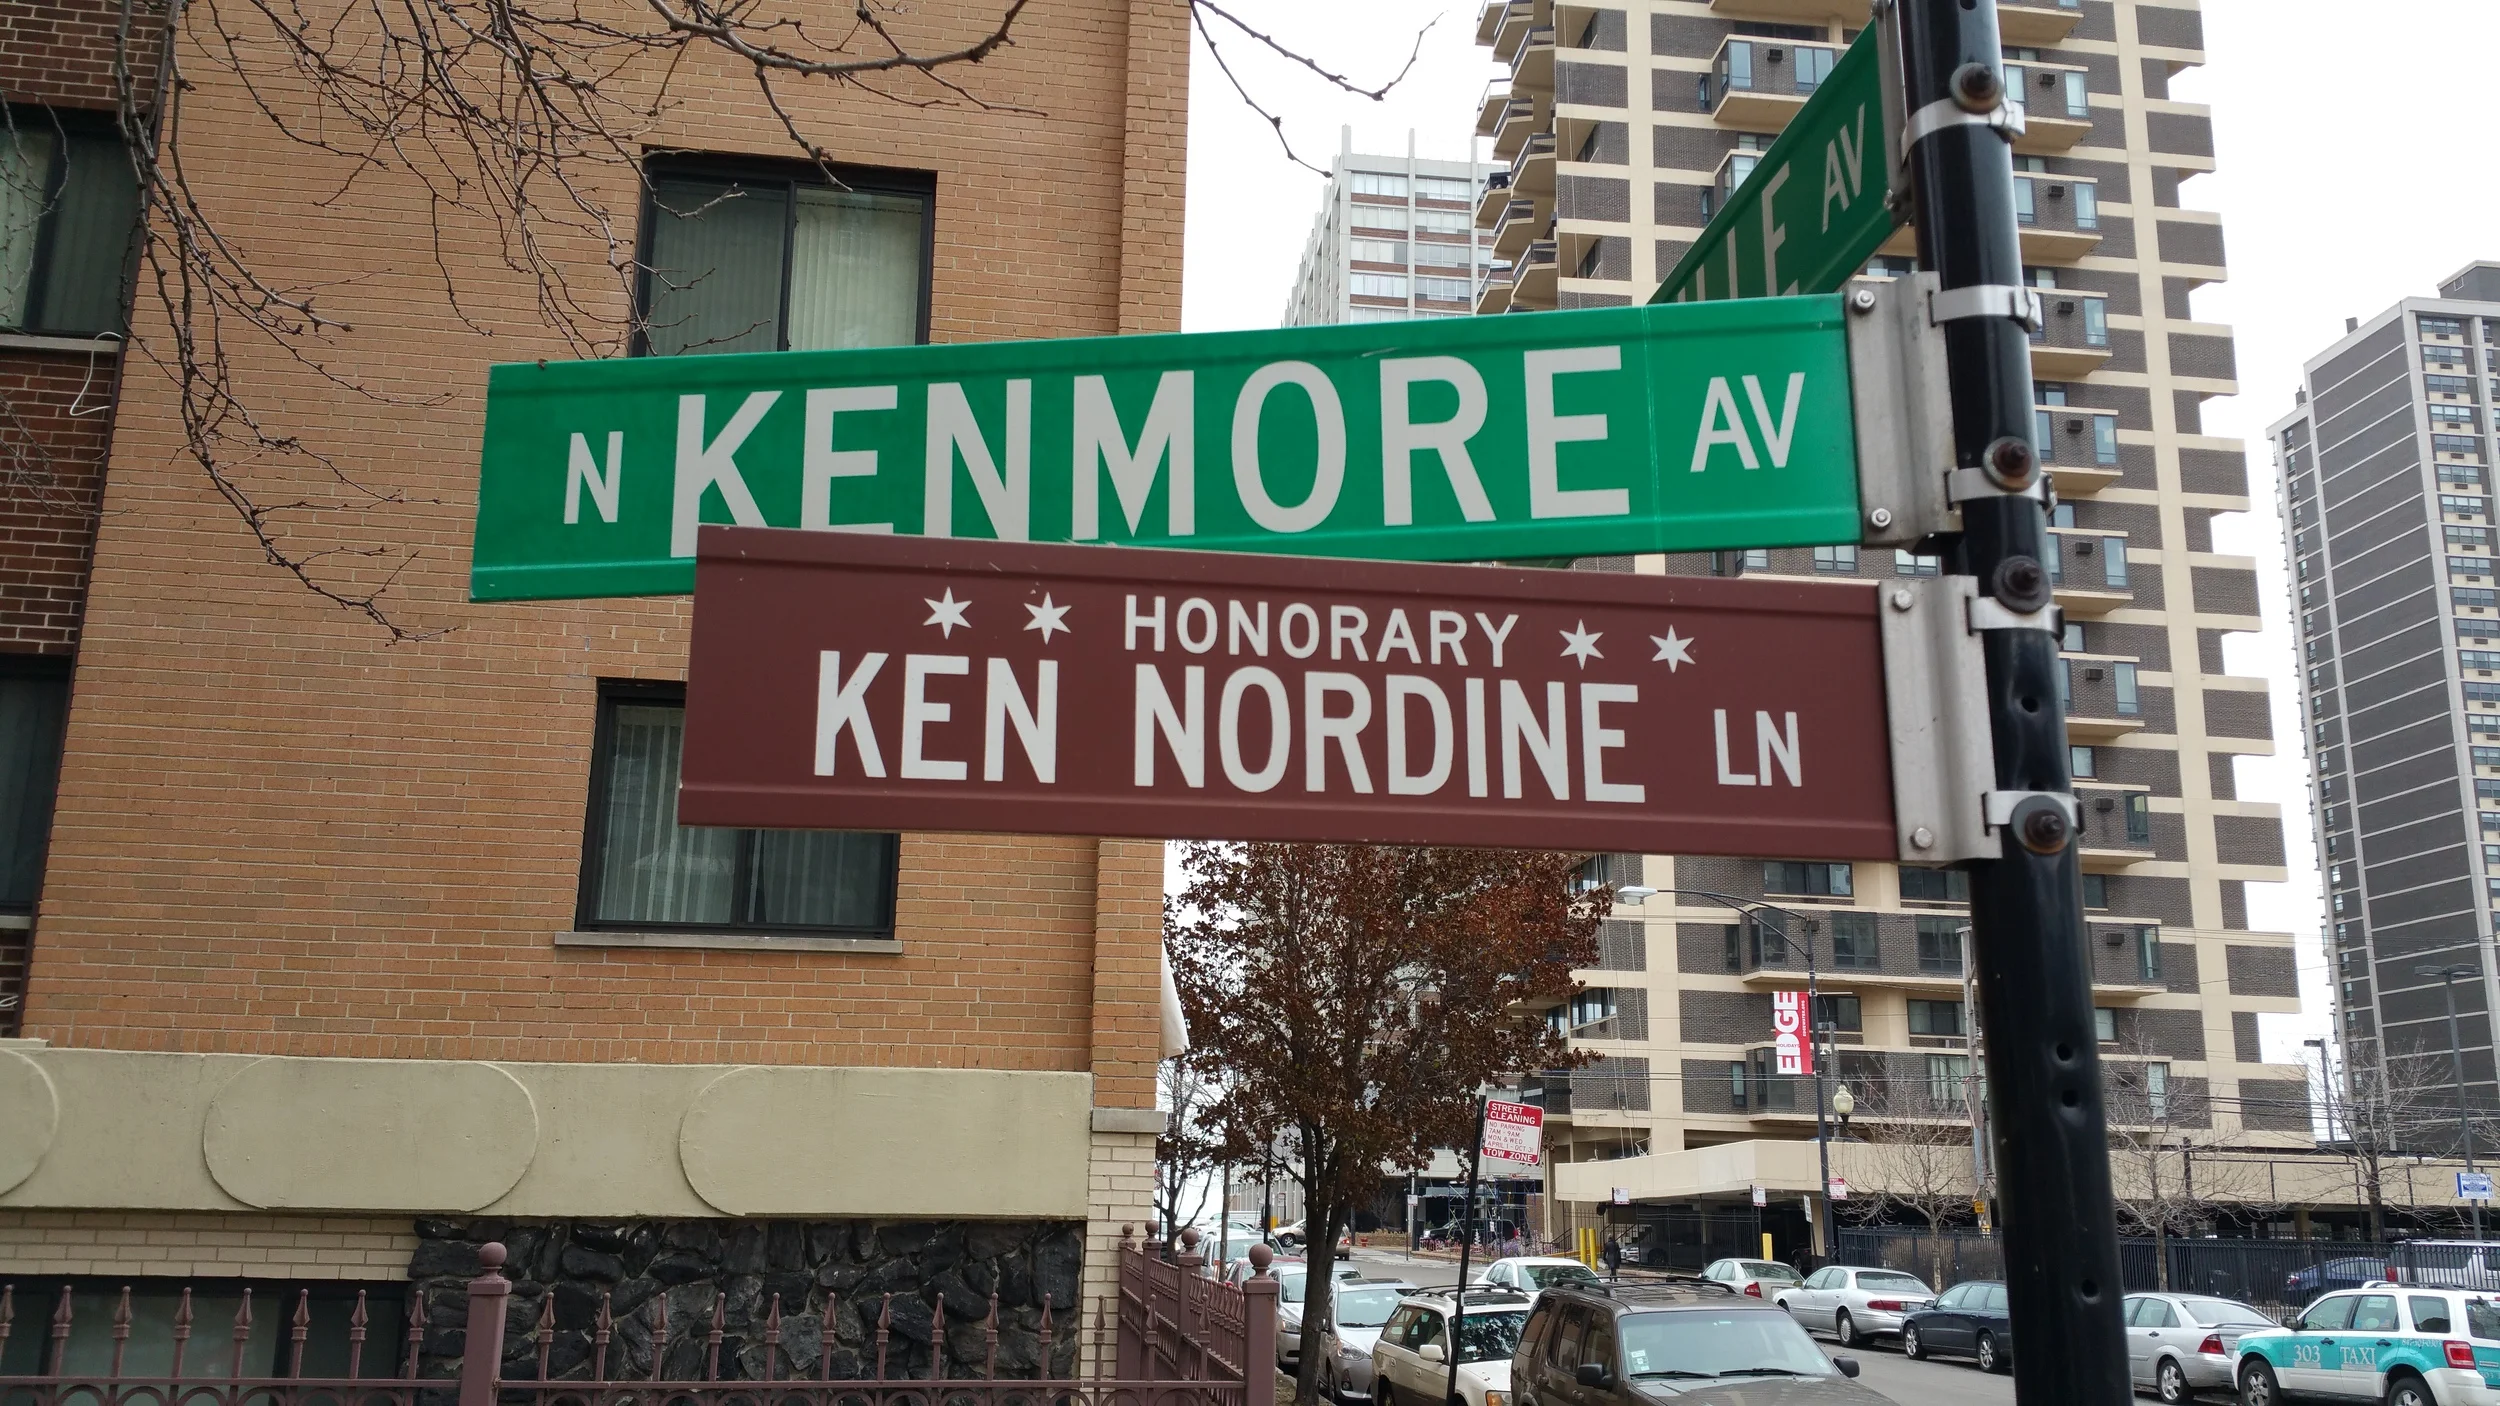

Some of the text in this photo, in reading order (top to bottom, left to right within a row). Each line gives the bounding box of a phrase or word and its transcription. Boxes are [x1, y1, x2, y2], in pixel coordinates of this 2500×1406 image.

[1821, 101, 1866, 235] AV
[563, 345, 1806, 558] N KENMORE AV
[1124, 594, 1520, 668] HONORARY
[813, 650, 1803, 803] KEN NORDINE LN
[1773, 992, 1802, 1074] EDGE
[1492, 1103, 1523, 1114] STREET
[1490, 1111, 1535, 1124] CLEANING
[1488, 1127, 1502, 1135] 7AM
[1507, 1130, 1521, 1138] 9AM
[1500, 1122, 1525, 1132] PARKING
[1487, 1140, 1504, 1148] APRIL
[1509, 1137, 1524, 1145] WED
[1486, 1148, 1534, 1163] TOW ZONE
[2293, 1344, 2377, 1366] 303 TAXI
